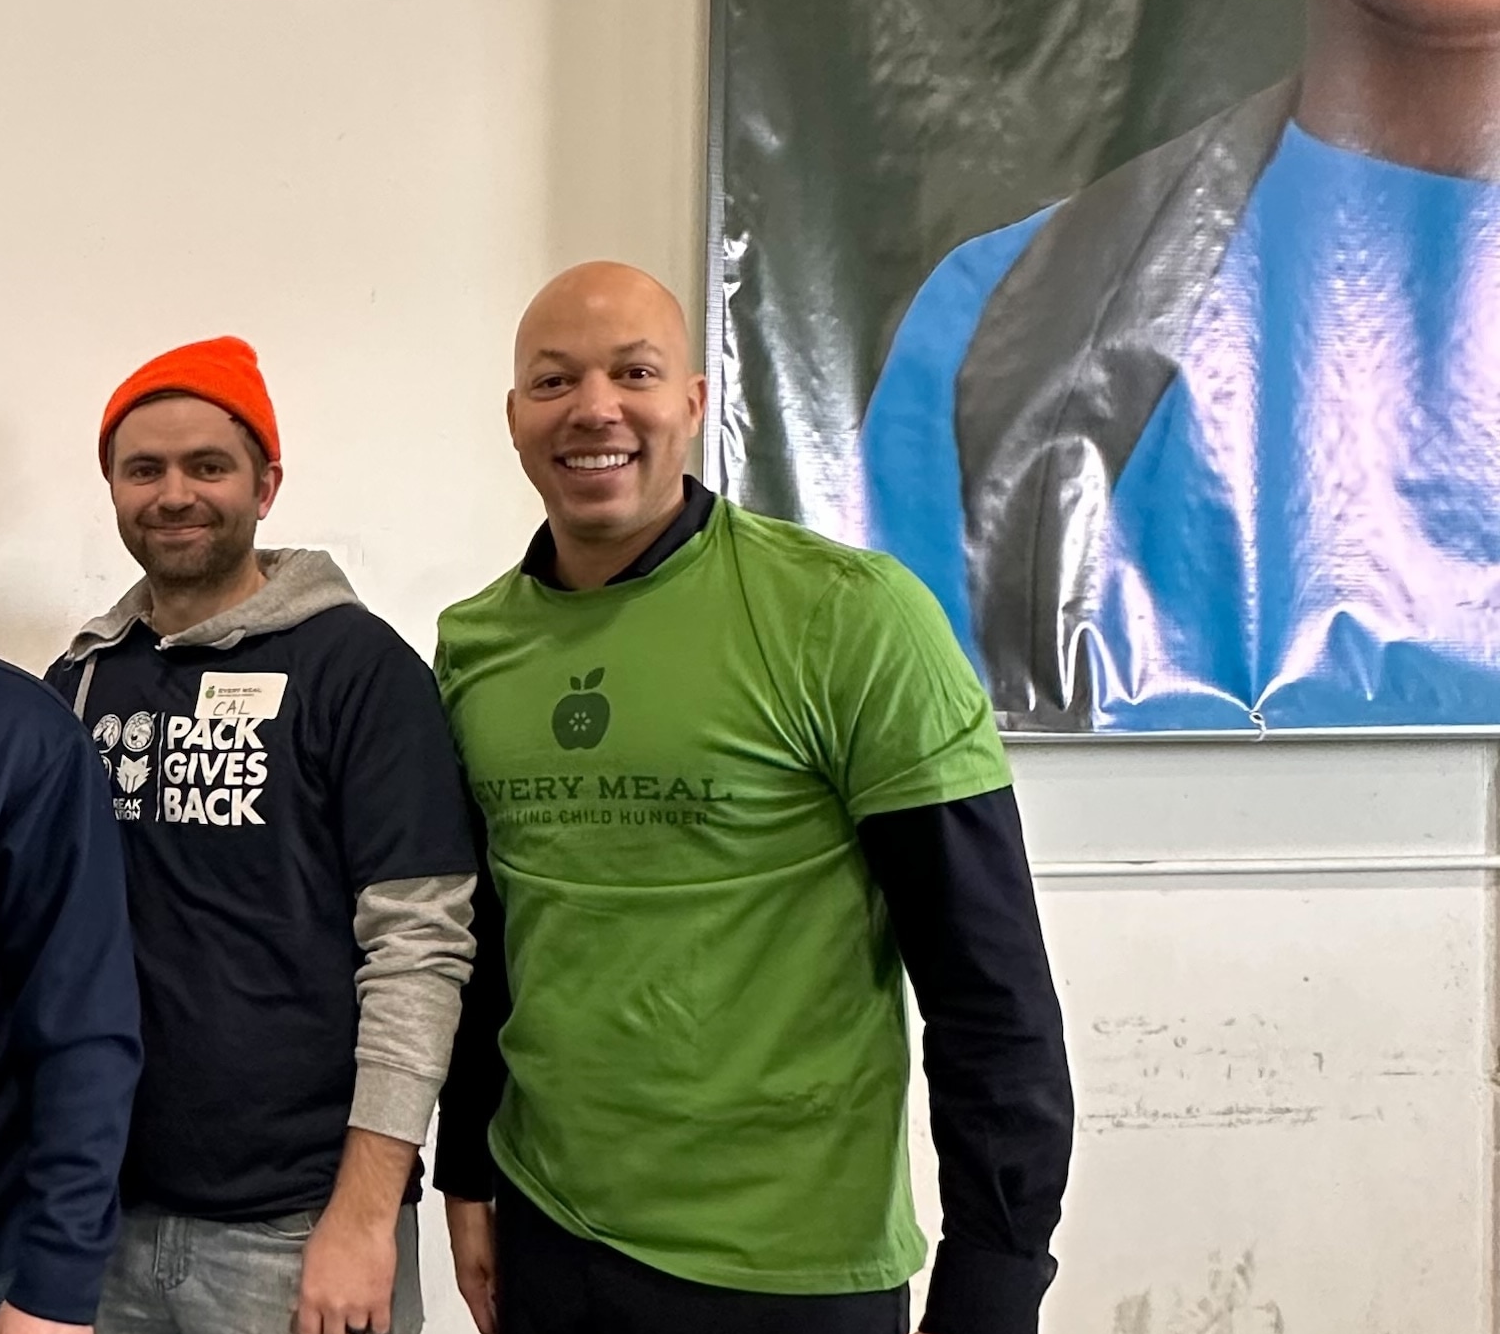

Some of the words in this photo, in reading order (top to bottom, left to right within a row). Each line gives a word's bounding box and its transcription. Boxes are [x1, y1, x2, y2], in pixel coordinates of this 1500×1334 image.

[212, 699, 251, 717] CAL
[167, 715, 265, 751] PACK
[163, 751, 269, 787] GIVES
[475, 775, 584, 802] EVERY
[598, 775, 733, 802] MEAL
[163, 787, 267, 826] BACK
[558, 809, 612, 826] CHILD
[620, 809, 708, 826] HUNGER
